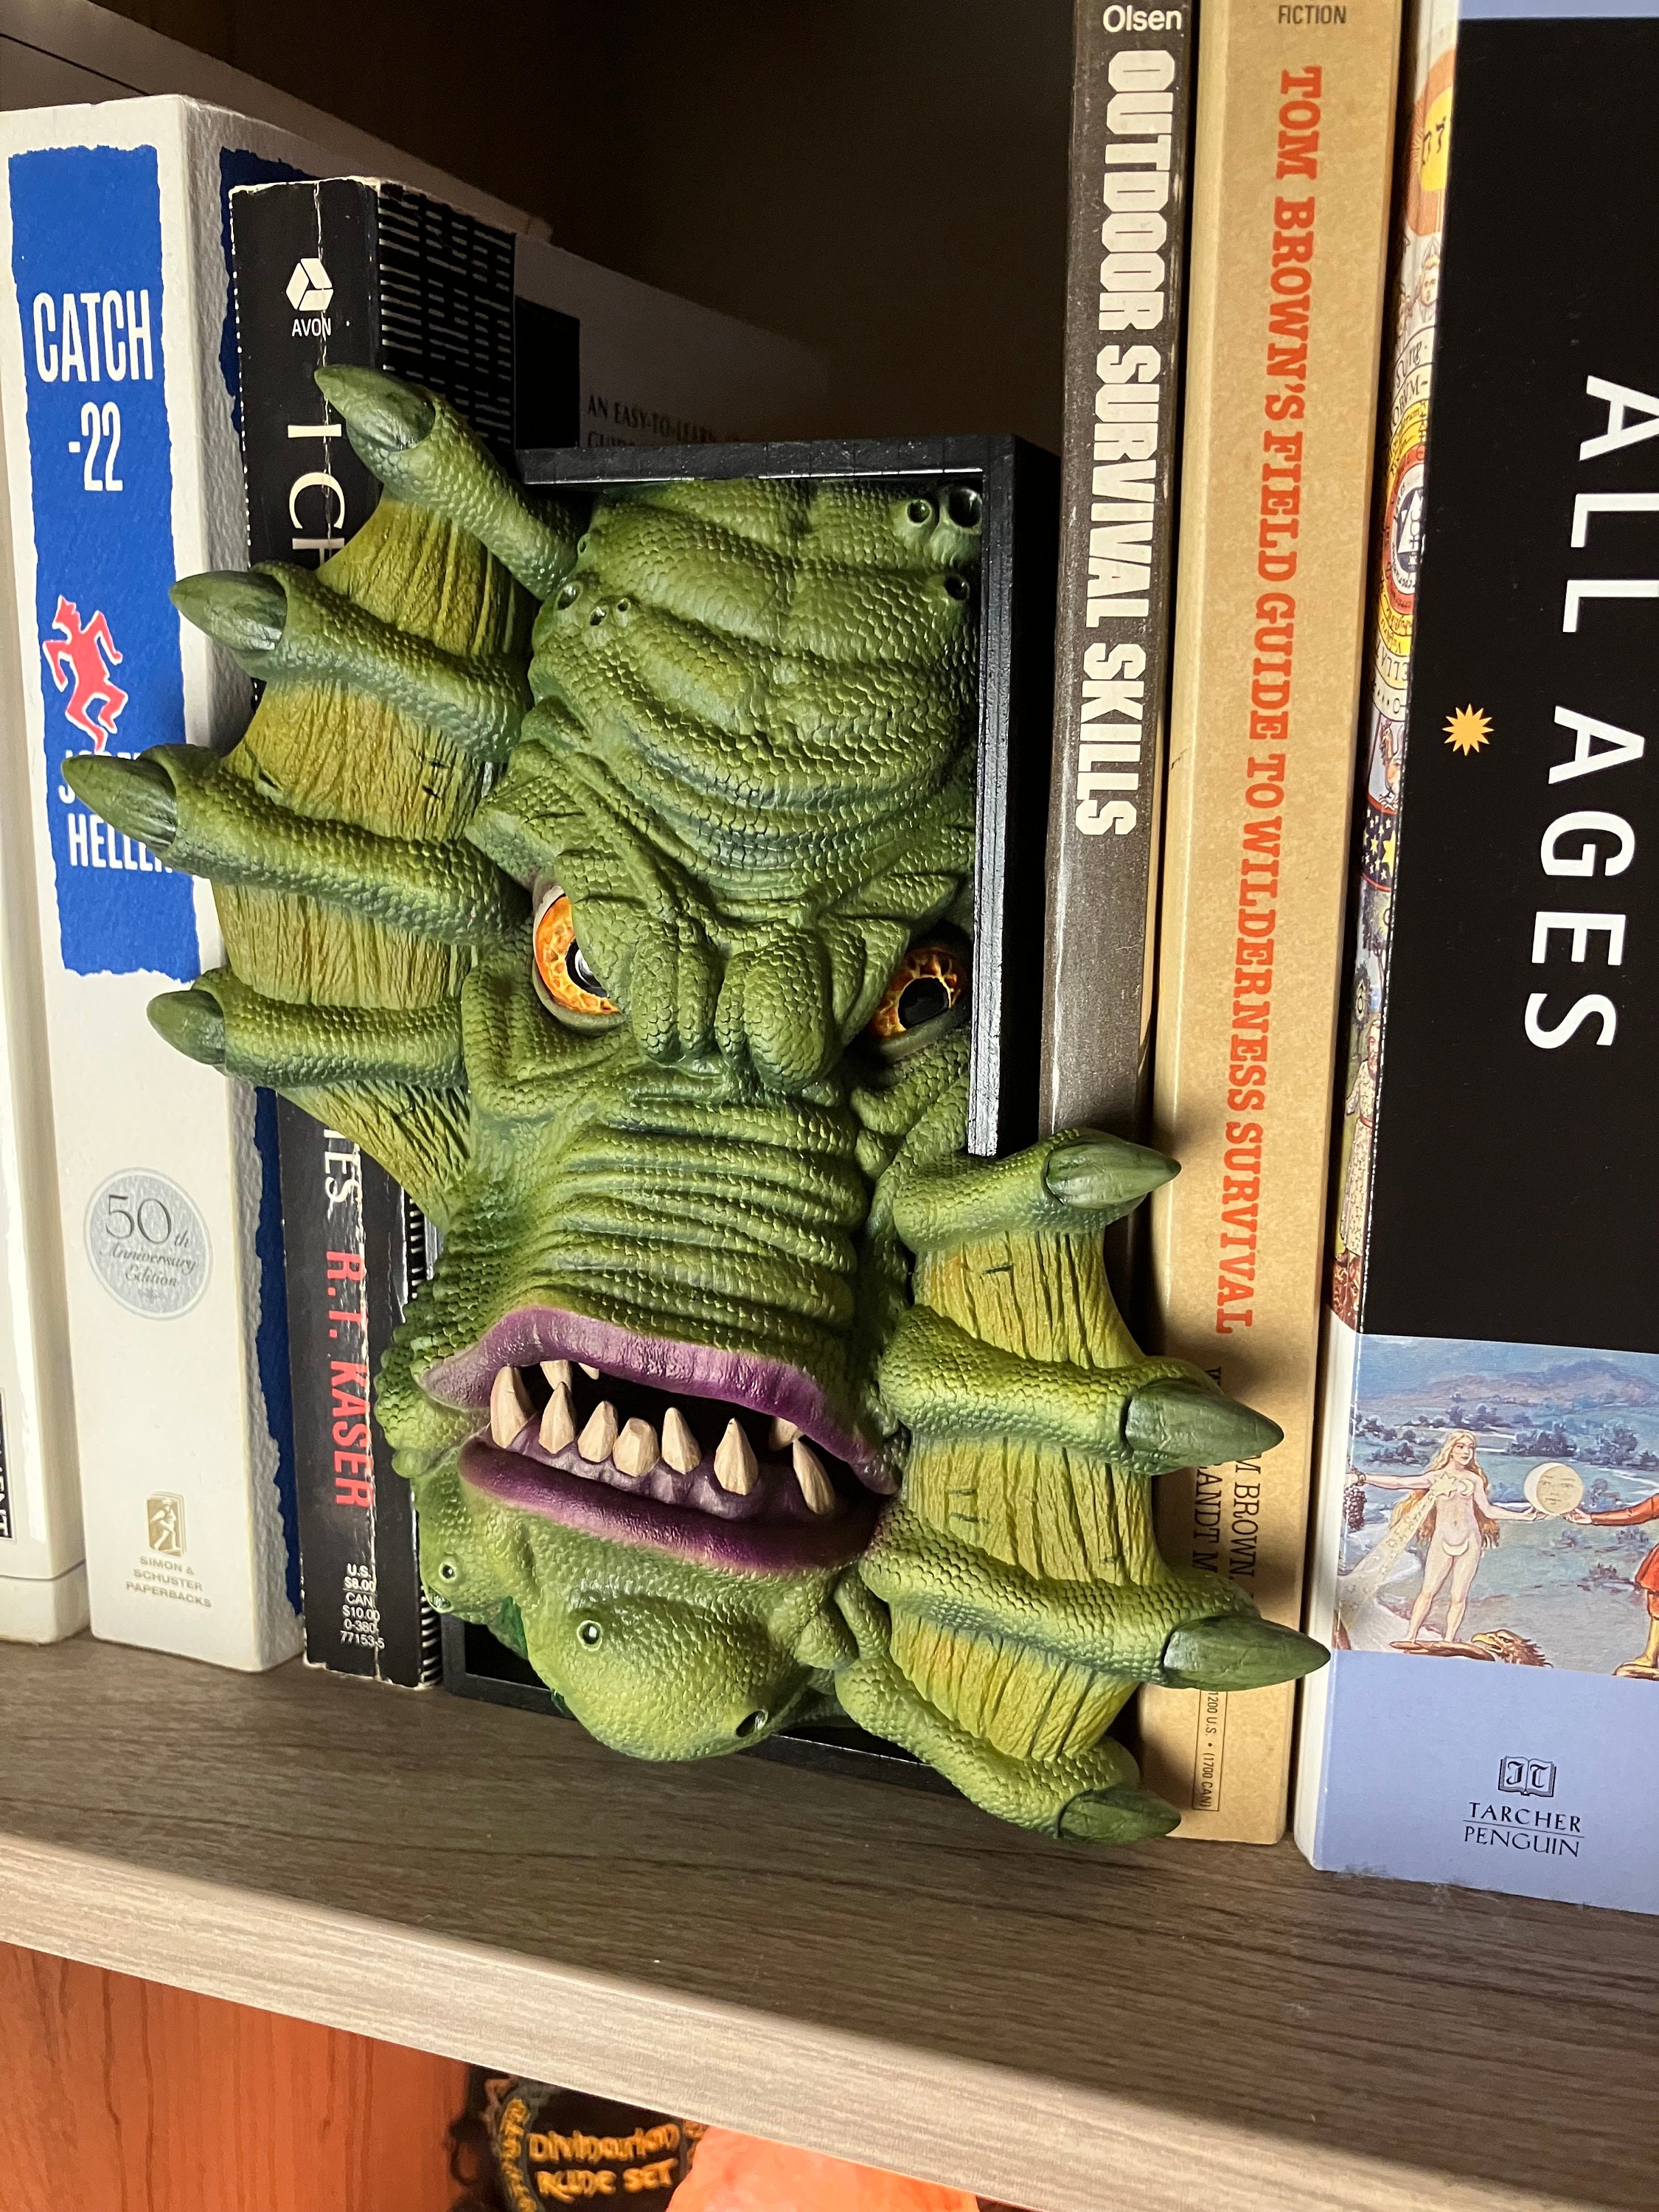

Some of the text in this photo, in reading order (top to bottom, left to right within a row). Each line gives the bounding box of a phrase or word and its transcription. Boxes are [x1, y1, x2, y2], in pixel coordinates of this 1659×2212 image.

[1103, 4, 1182, 32] Olsen
[1278, 4, 1347, 24] FICTION
[32, 289, 153, 383] CATCH
[291, 318, 332, 337] AVON
[68, 402, 123, 492] -22
[1075, 49, 1175, 835] OUTDOOR SURVIVAL SKILLS
[1217, 67, 1322, 1332] TOM BROWN'S FIELD GUIDE TO WILDERNESS SURVIVAL
[1524, 375, 1659, 1049] ALL AGES
[98, 1242, 196, 1276] Anniversary
[125, 1263, 178, 1287] Edition
[330, 1361, 376, 1508] KASER
[133, 1568, 204, 1592] SCHUSTER
[139, 1556, 195, 1576] SIMON &
[347, 1562, 372, 1579] U.S.
[125, 1581, 212, 1608] PAPERBACKS
[344, 1576, 377, 1593] $8.00
[342, 1604, 381, 1623] $10.00
[341, 1630, 386, 1650] 77153-5
[1201, 1752, 1216, 1779] (1700
[1199, 1780, 1214, 1808] CAN)
[1469, 1801, 1582, 1834] TARCHER
[1464, 1825, 1580, 1858] PENGUIN
[622, 2157, 679, 2194] SET
